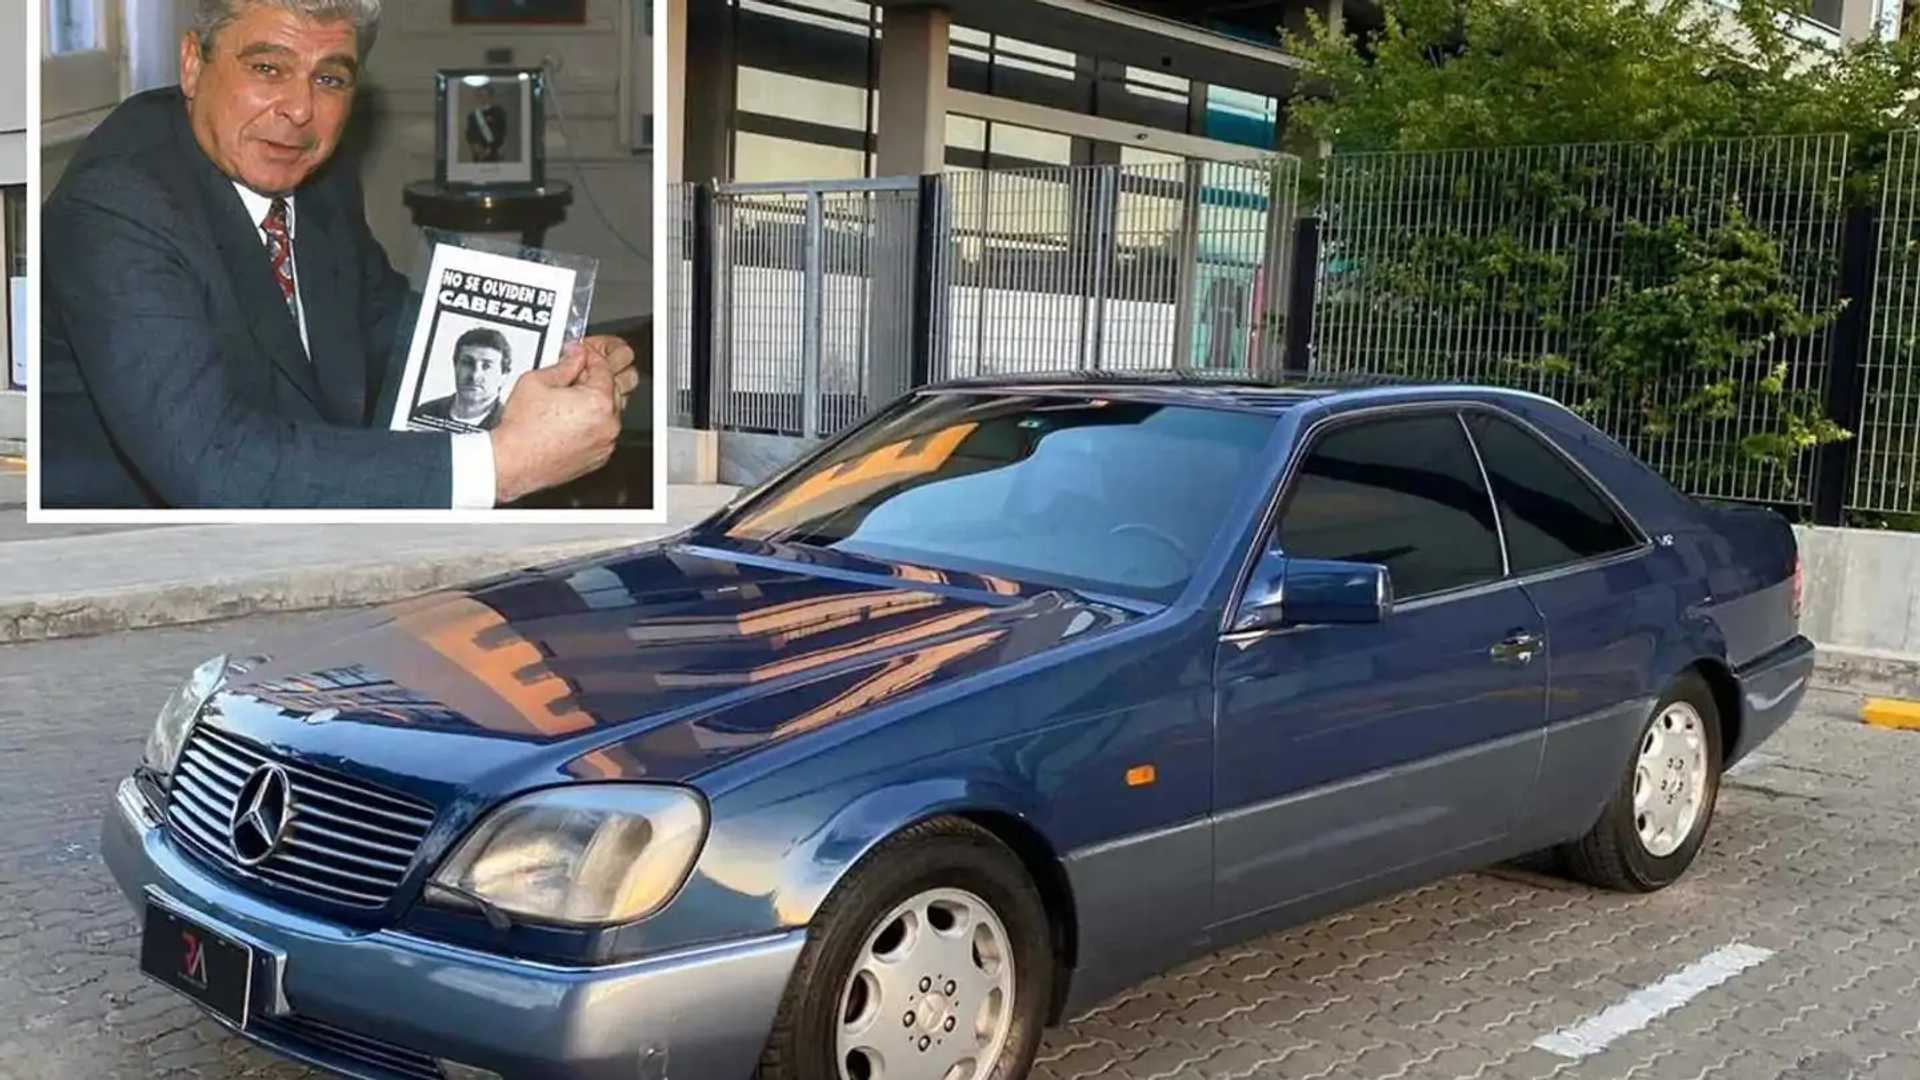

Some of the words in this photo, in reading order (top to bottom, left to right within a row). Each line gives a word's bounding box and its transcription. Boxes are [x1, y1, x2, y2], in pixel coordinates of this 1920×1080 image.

[442, 271, 462, 288] NO
[465, 275, 479, 292] SE
[482, 279, 534, 304] OLVIDEN
[538, 290, 555, 308] DE
[439, 290, 550, 326] CABEZAS
